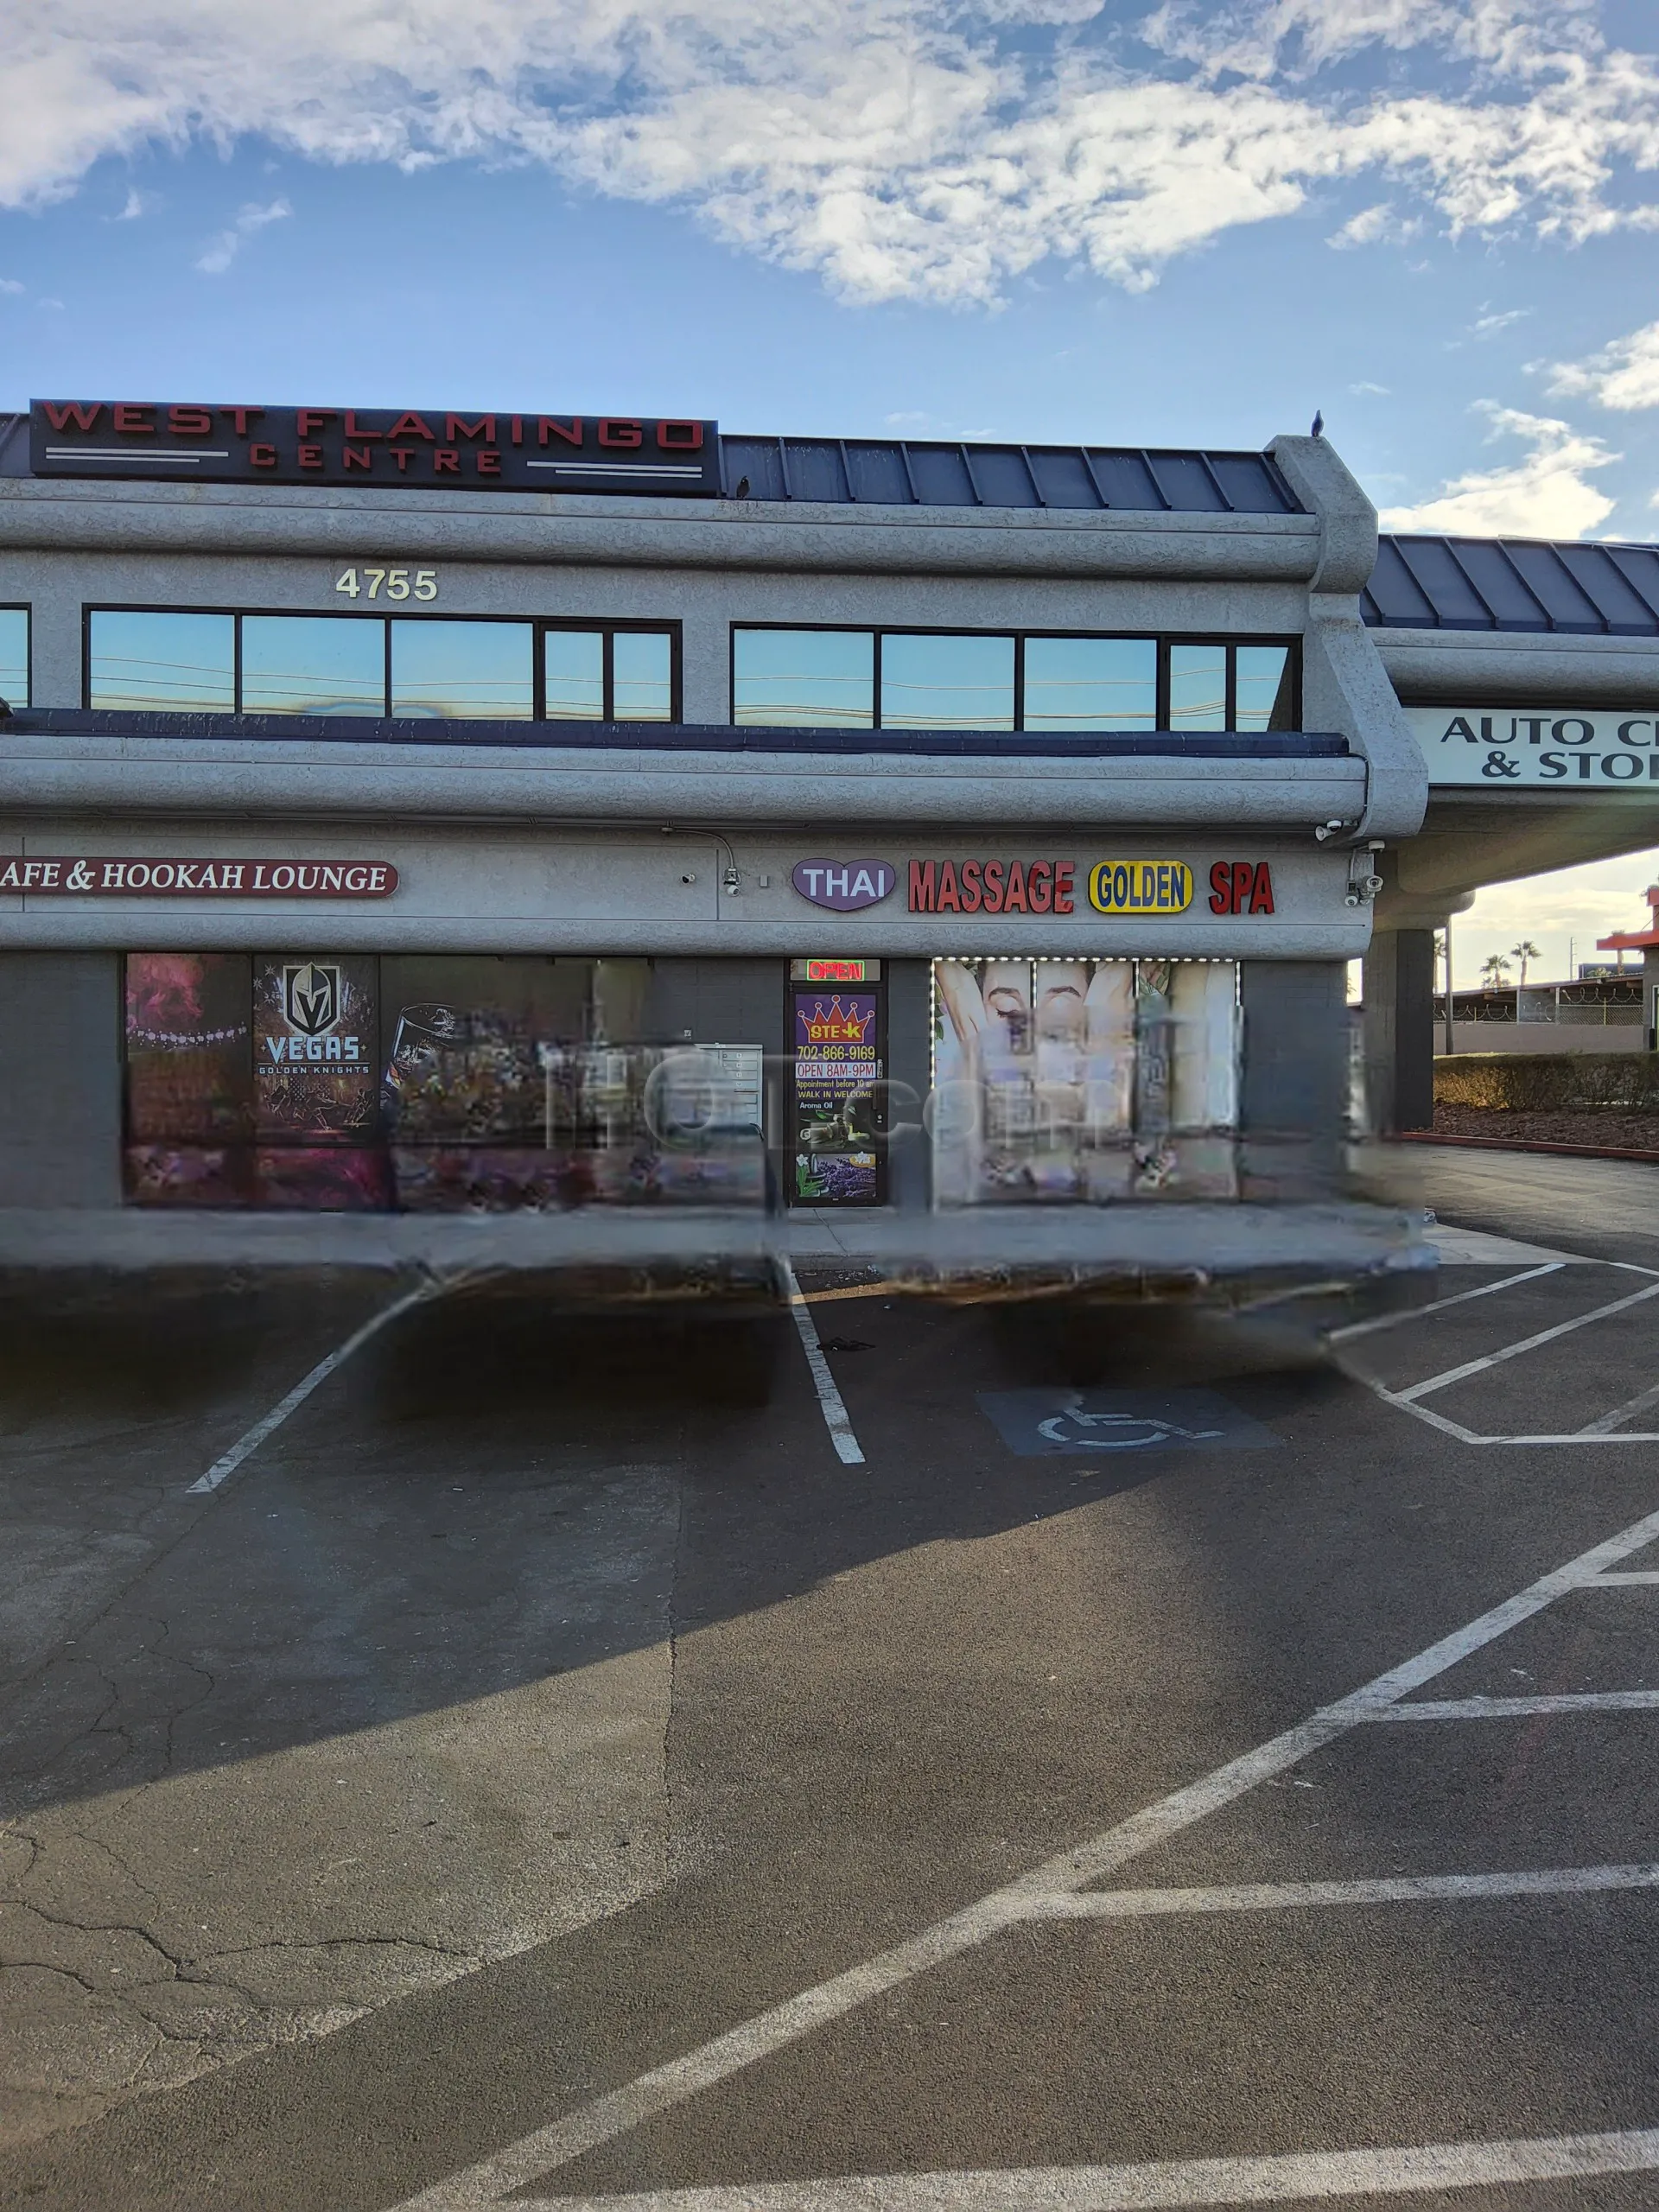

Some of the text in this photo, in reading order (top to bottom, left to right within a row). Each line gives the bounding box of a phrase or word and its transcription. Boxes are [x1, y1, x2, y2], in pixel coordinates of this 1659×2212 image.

[43, 401, 703, 449] WEST FLAMINGO
[249, 442, 502, 474] CENTRE
[335, 567, 438, 601] 4755
[1440, 716, 1659, 747] AUTO C
[1481, 750, 1521, 778] &
[66, 860, 96, 890] &
[101, 863, 245, 890] HOOKAH
[252, 866, 387, 891] LOUNGE
[802, 868, 885, 897] THAI
[908, 860, 1074, 913] MASSAGE
[1096, 861, 1185, 907] GOLDEN
[1209, 861, 1274, 914] SPA
[809, 962, 861, 979] OPEN
[266, 1036, 359, 1065] VEGAS
[797, 1046, 875, 1060] 702-866-9169
[796, 1079, 834, 1090] Appointment
[836, 1079, 855, 1088] before
[857, 1079, 864, 1088] 10
[798, 1064, 823, 1077] OPEN
[827, 1064, 874, 1077] 8AM-9PM
